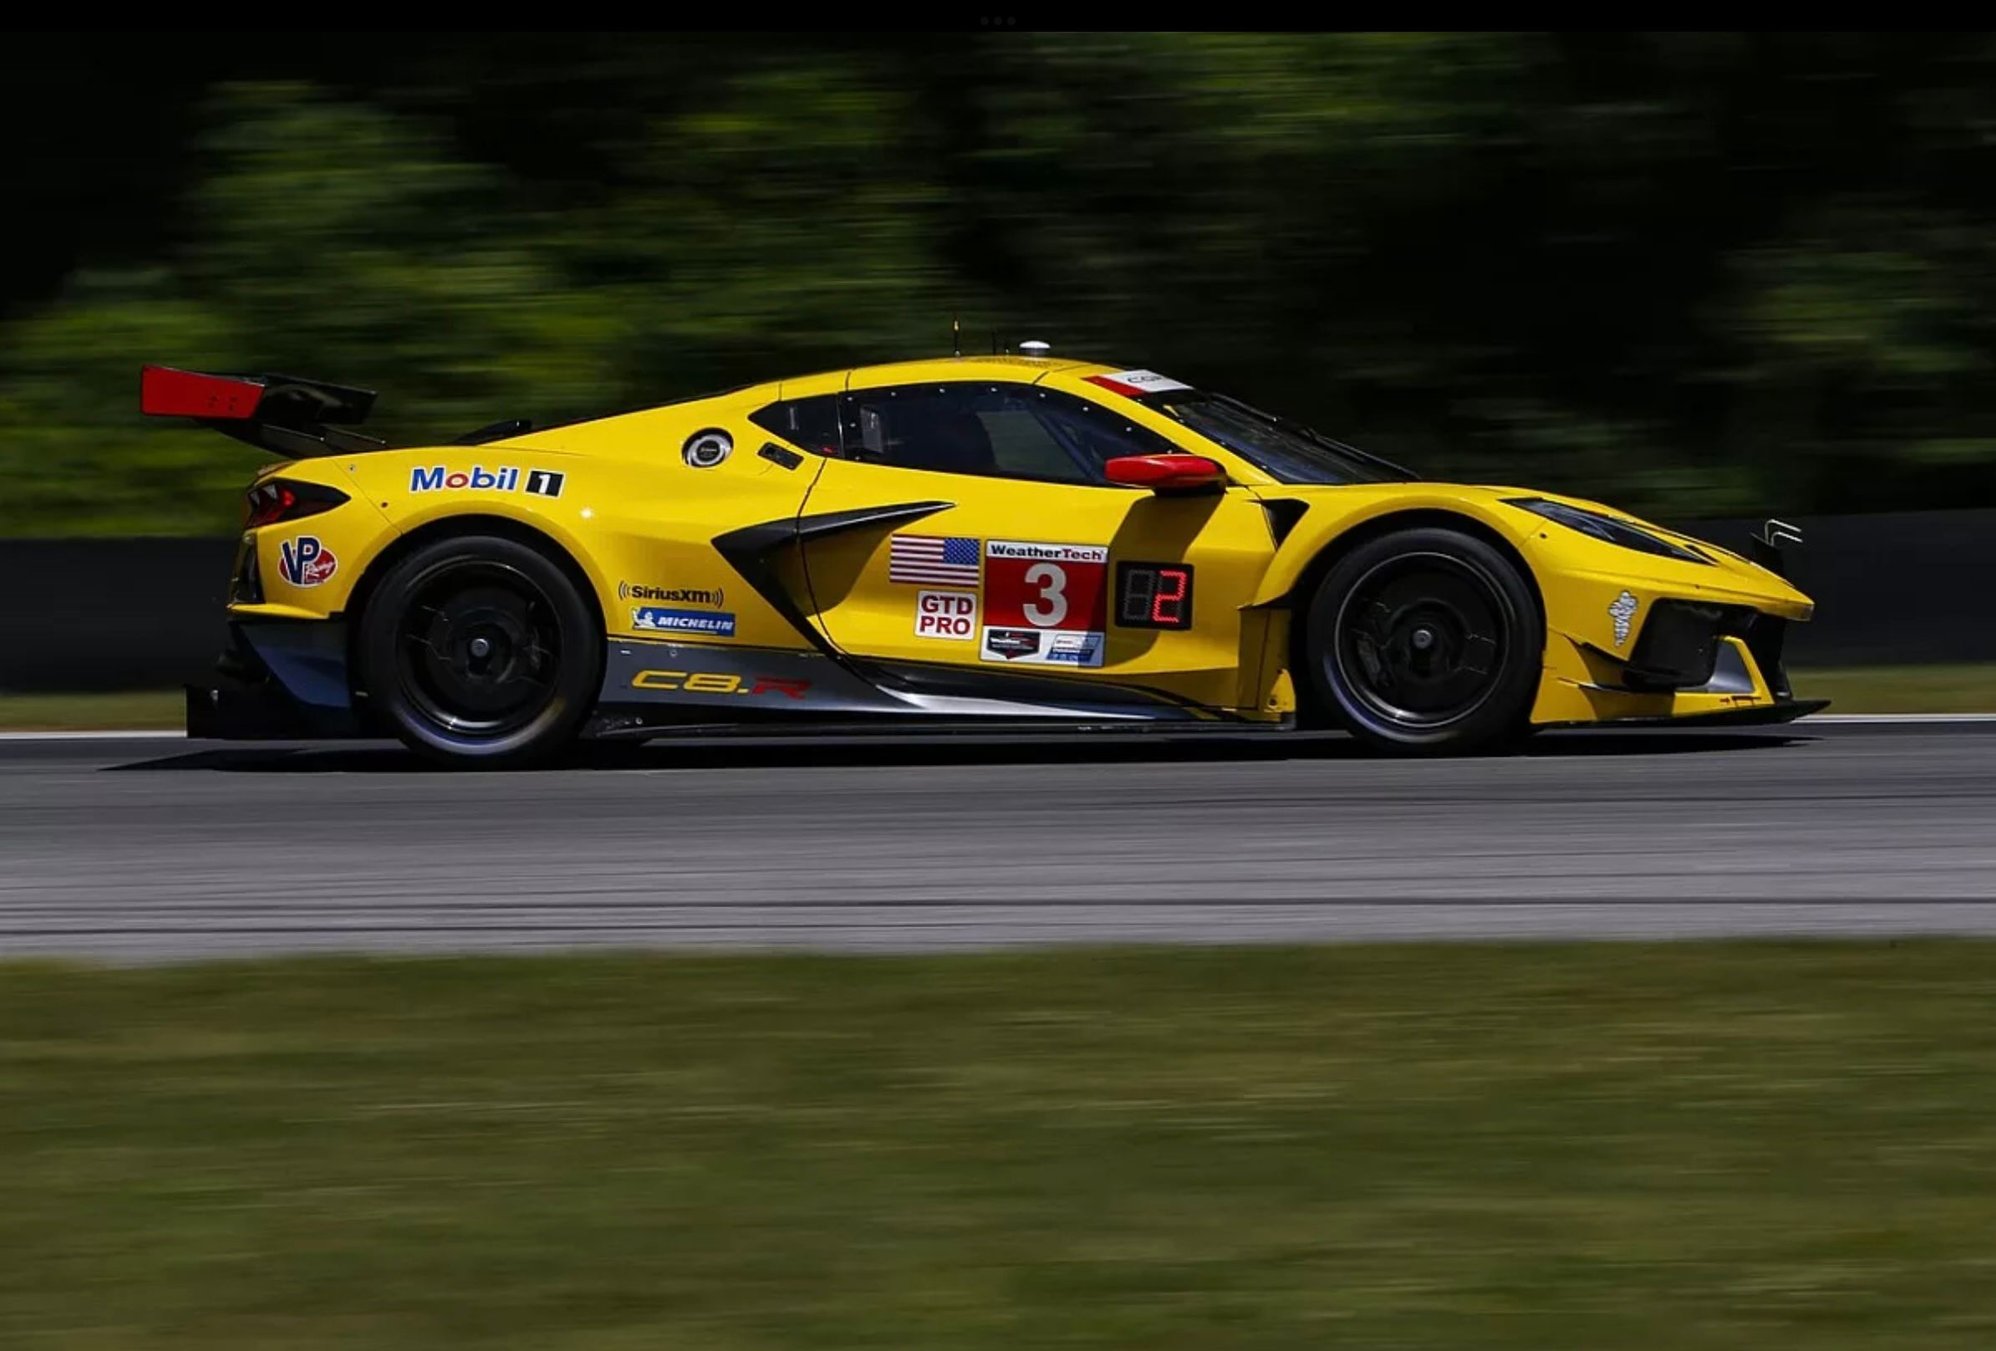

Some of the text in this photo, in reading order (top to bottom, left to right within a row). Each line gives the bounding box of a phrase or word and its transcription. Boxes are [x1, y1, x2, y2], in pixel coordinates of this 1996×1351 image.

[410, 467, 518, 492] Mobil
[282, 537, 320, 585] VP
[990, 544, 1103, 561] WeatherTech
[921, 595, 973, 615] GTD
[1022, 562, 1068, 627] 3
[1152, 569, 1188, 623] 2
[657, 616, 734, 631] MICHELIN
[919, 615, 971, 635] PRO
[631, 669, 812, 700] C8.R
